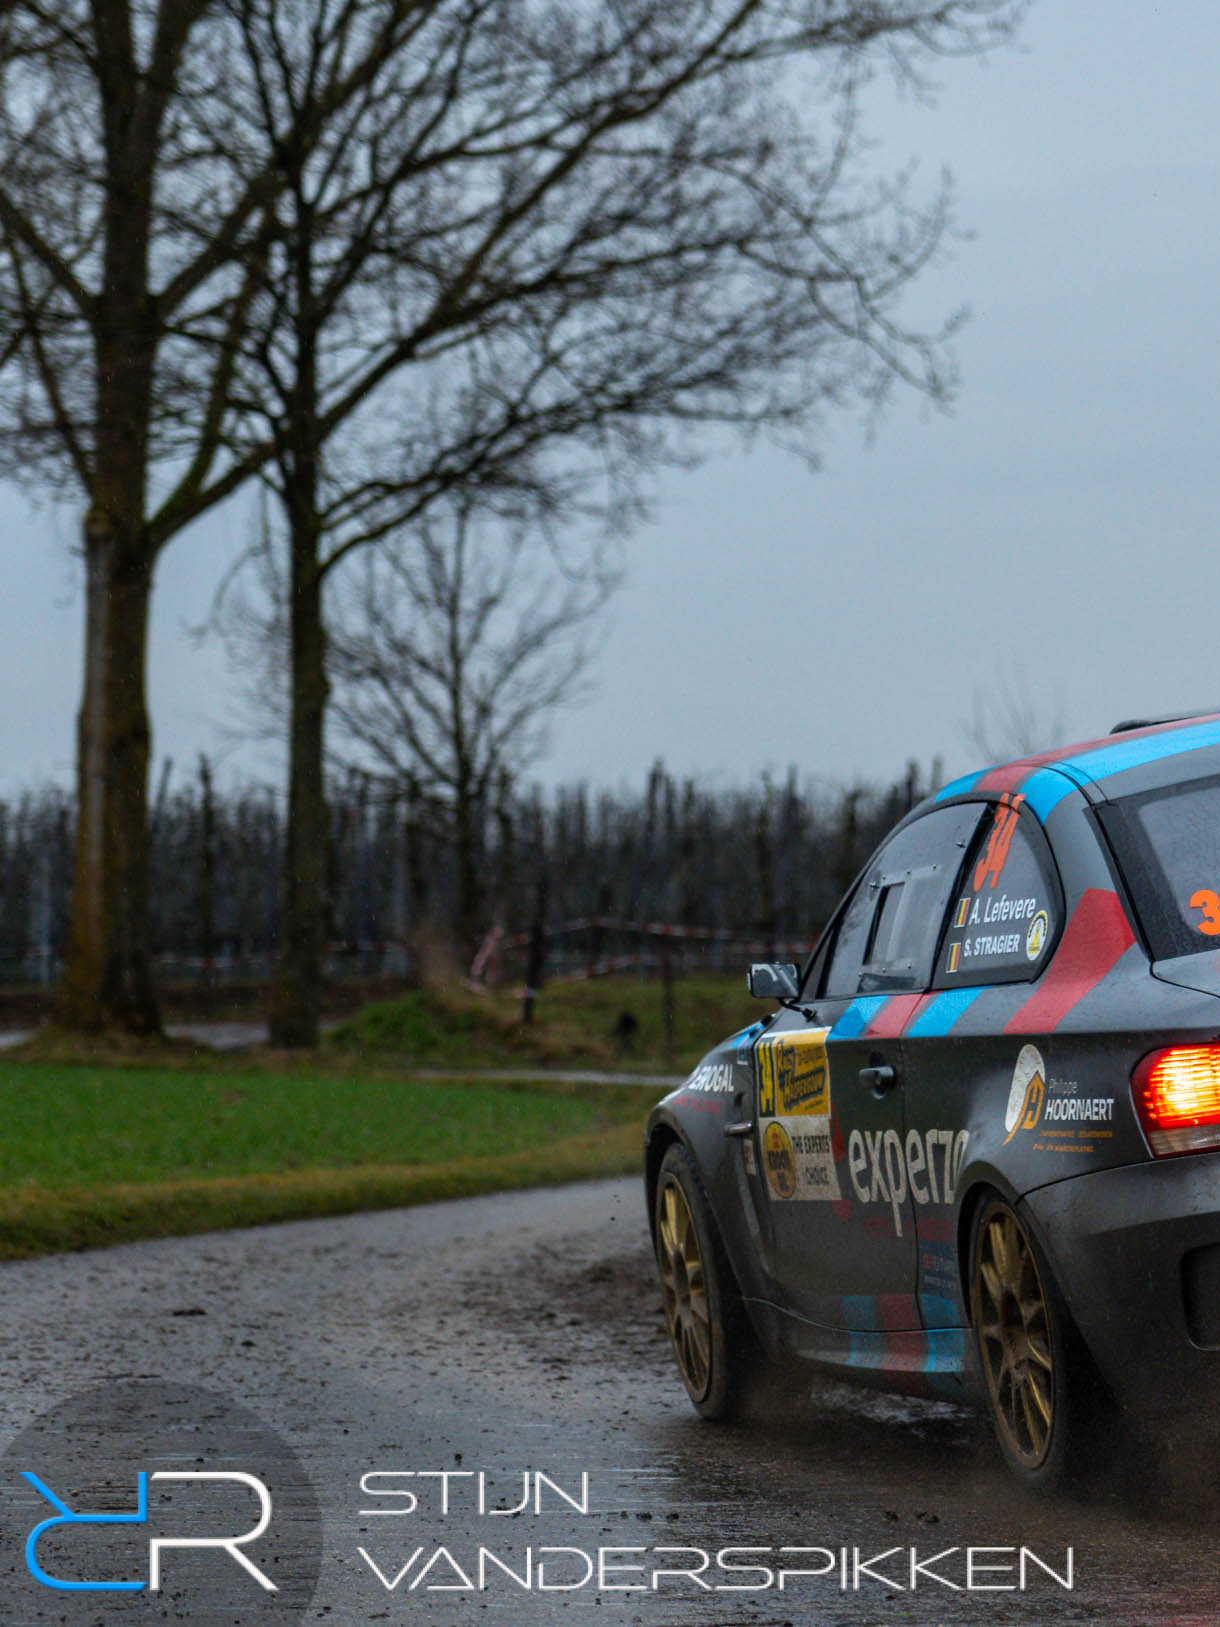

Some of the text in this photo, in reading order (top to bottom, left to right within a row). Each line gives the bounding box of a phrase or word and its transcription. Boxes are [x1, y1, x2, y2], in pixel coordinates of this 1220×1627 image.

[968, 894, 1037, 925] A. Lefevere
[963, 934, 1021, 957] S. STRAGIER
[1044, 1098, 1115, 1121] HOORNAERT
